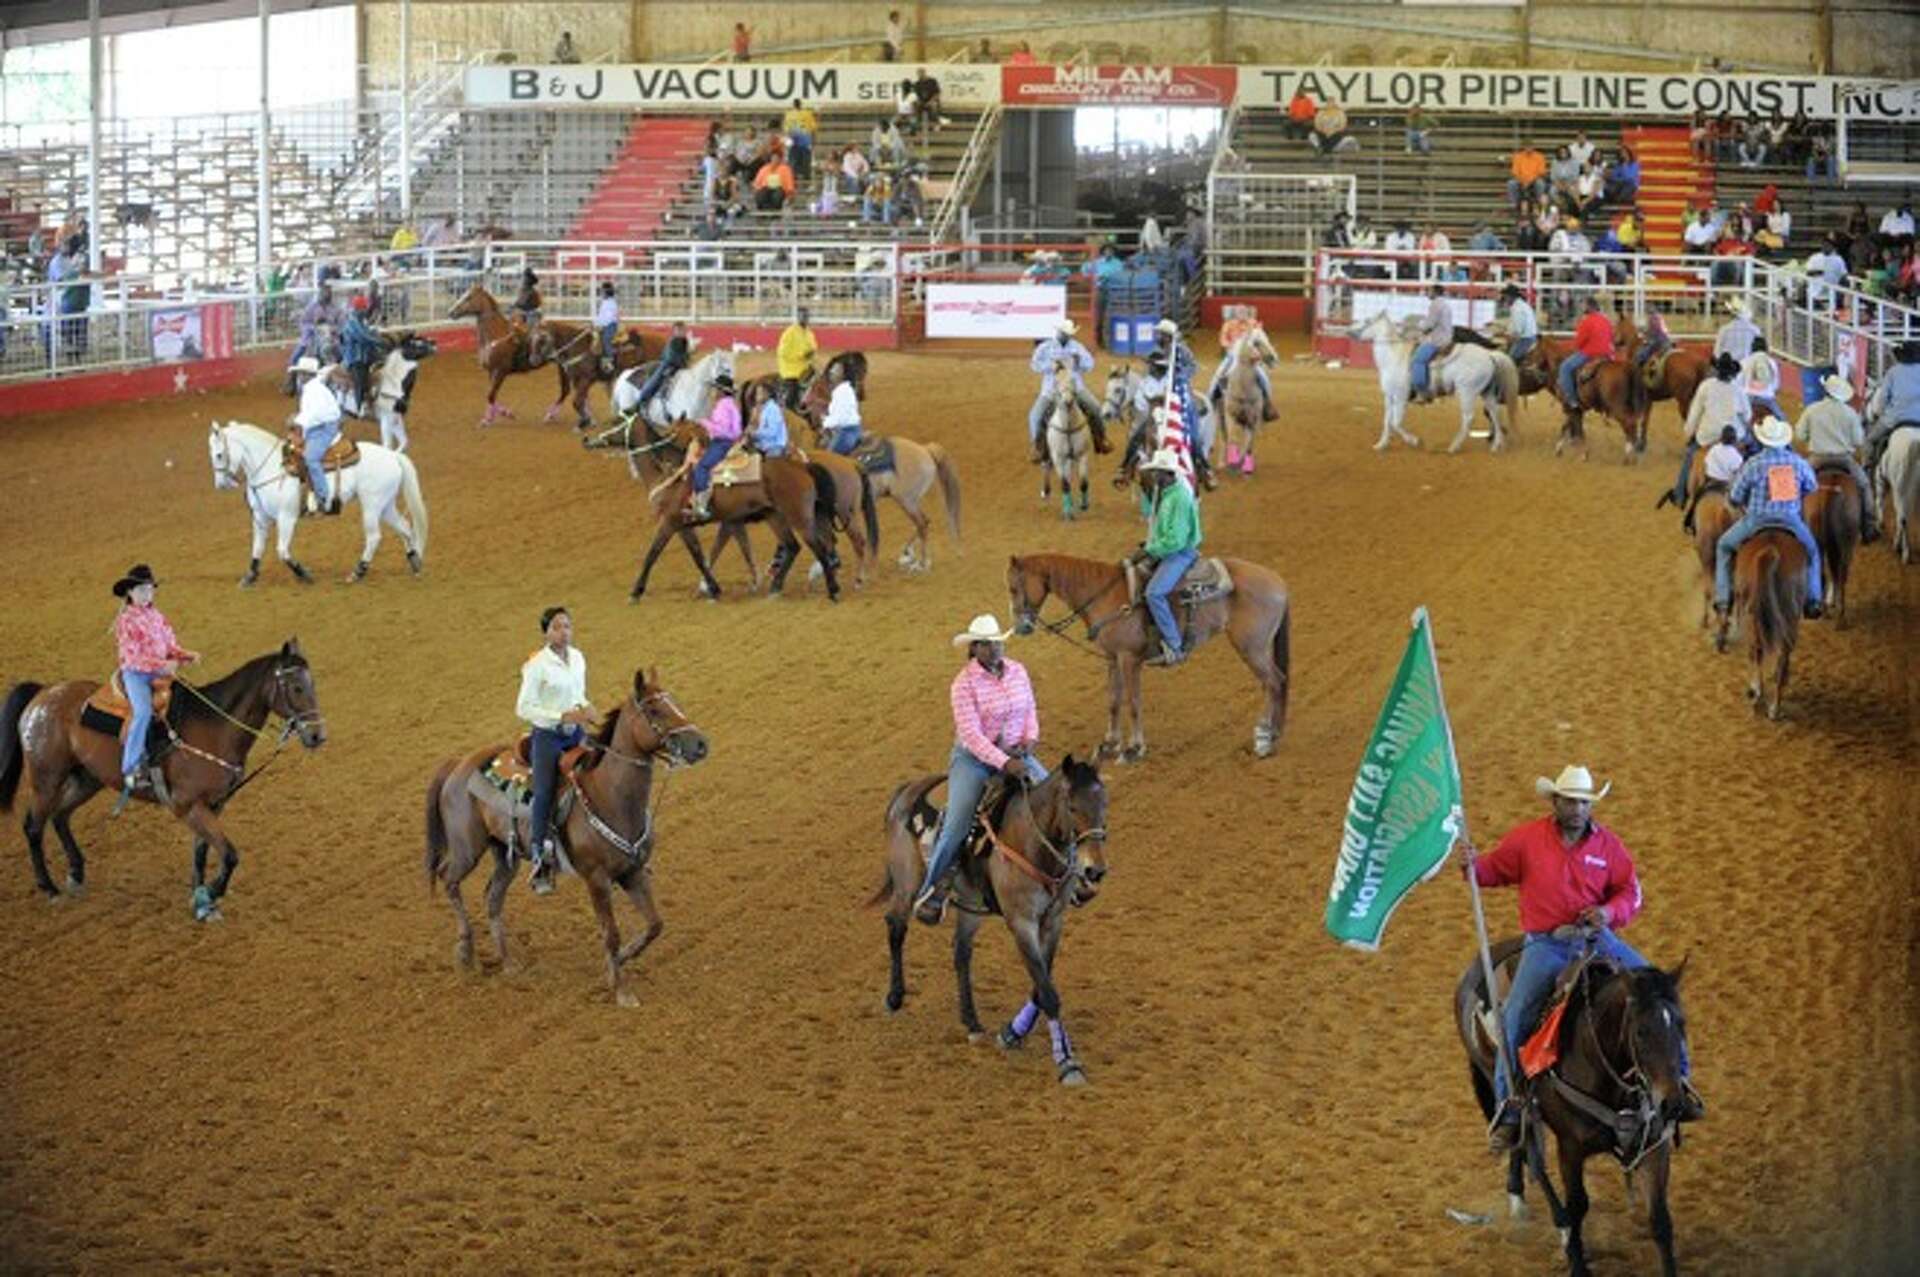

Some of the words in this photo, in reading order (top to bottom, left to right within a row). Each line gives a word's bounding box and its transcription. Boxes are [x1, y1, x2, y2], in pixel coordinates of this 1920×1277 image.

[509, 69, 539, 100] B
[550, 76, 566, 97] &
[575, 69, 603, 101] J
[633, 69, 839, 100] VACUUM
[1055, 66, 1172, 84] MILAM
[1262, 71, 1447, 105] TAYLOR
[1459, 74, 1647, 108] PIPELINE
[1660, 77, 1817, 113] CONST.
